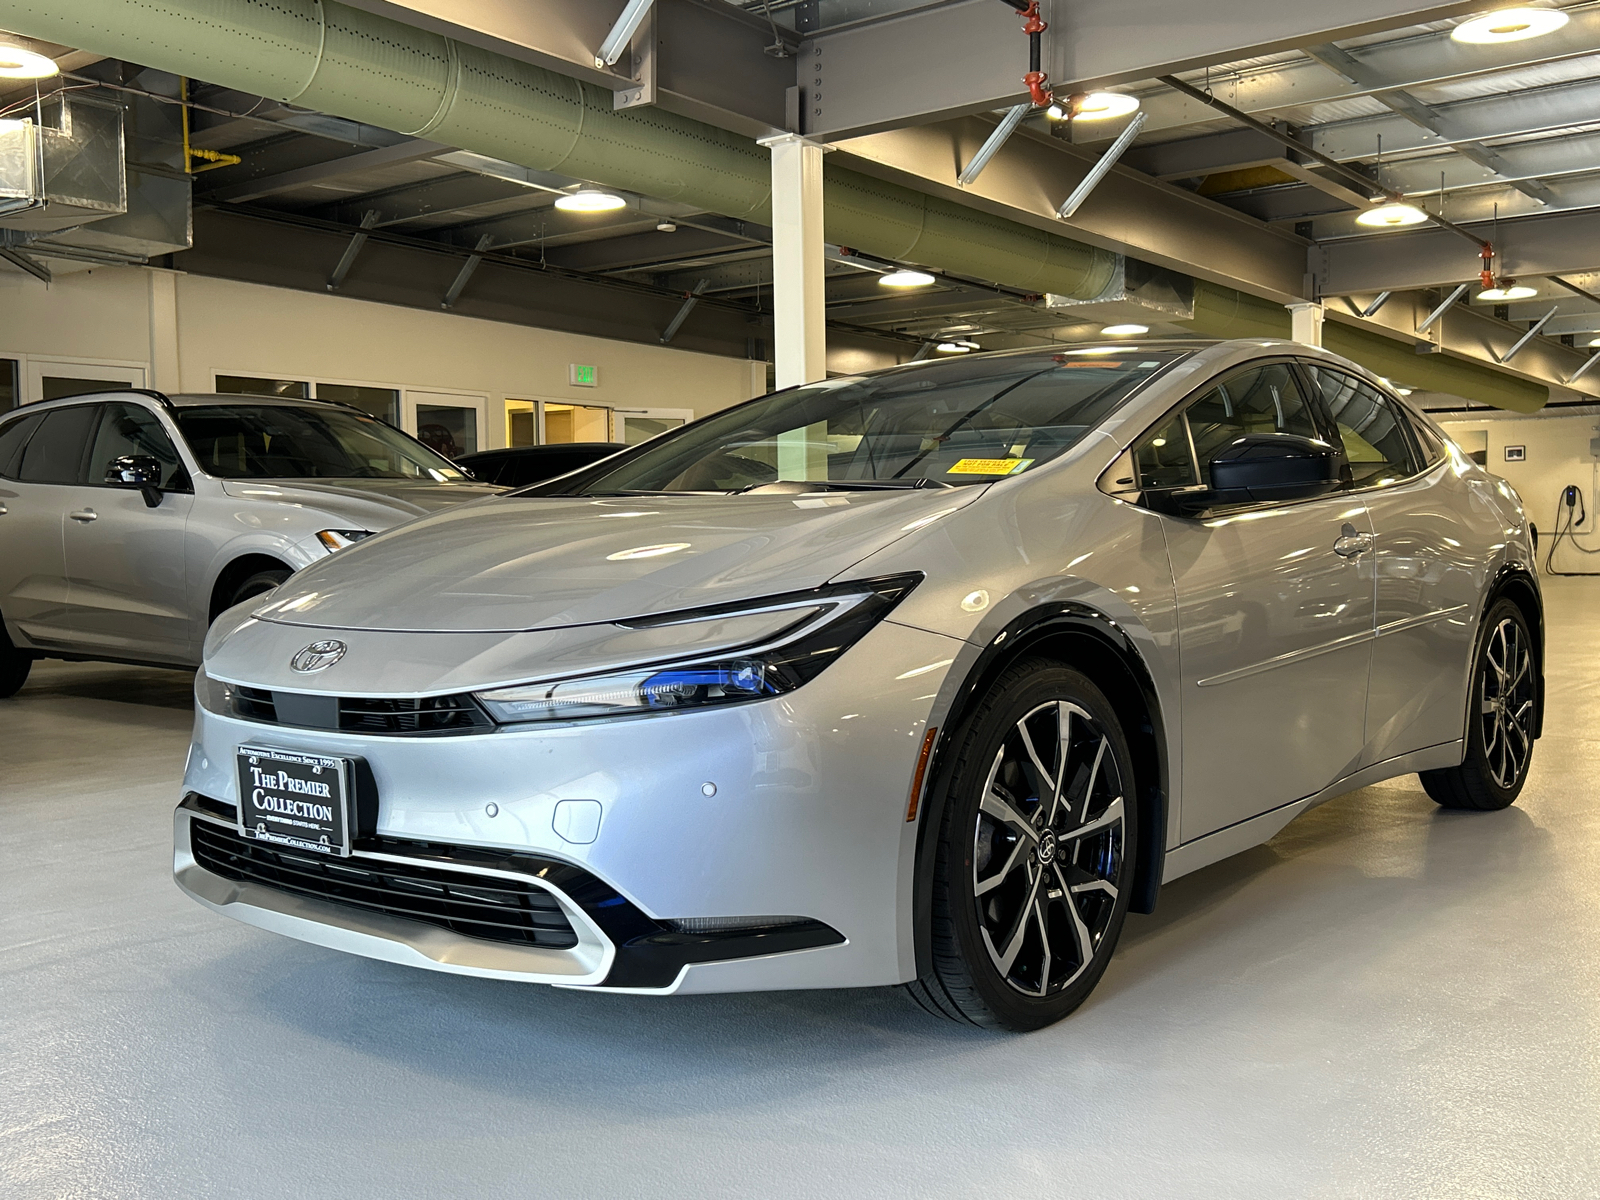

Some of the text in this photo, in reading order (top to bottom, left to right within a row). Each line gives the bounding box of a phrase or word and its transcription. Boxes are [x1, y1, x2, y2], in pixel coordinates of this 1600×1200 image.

[578, 366, 594, 383] EXIT
[320, 758, 335, 767] 1995
[252, 788, 333, 822] COLLECTION
